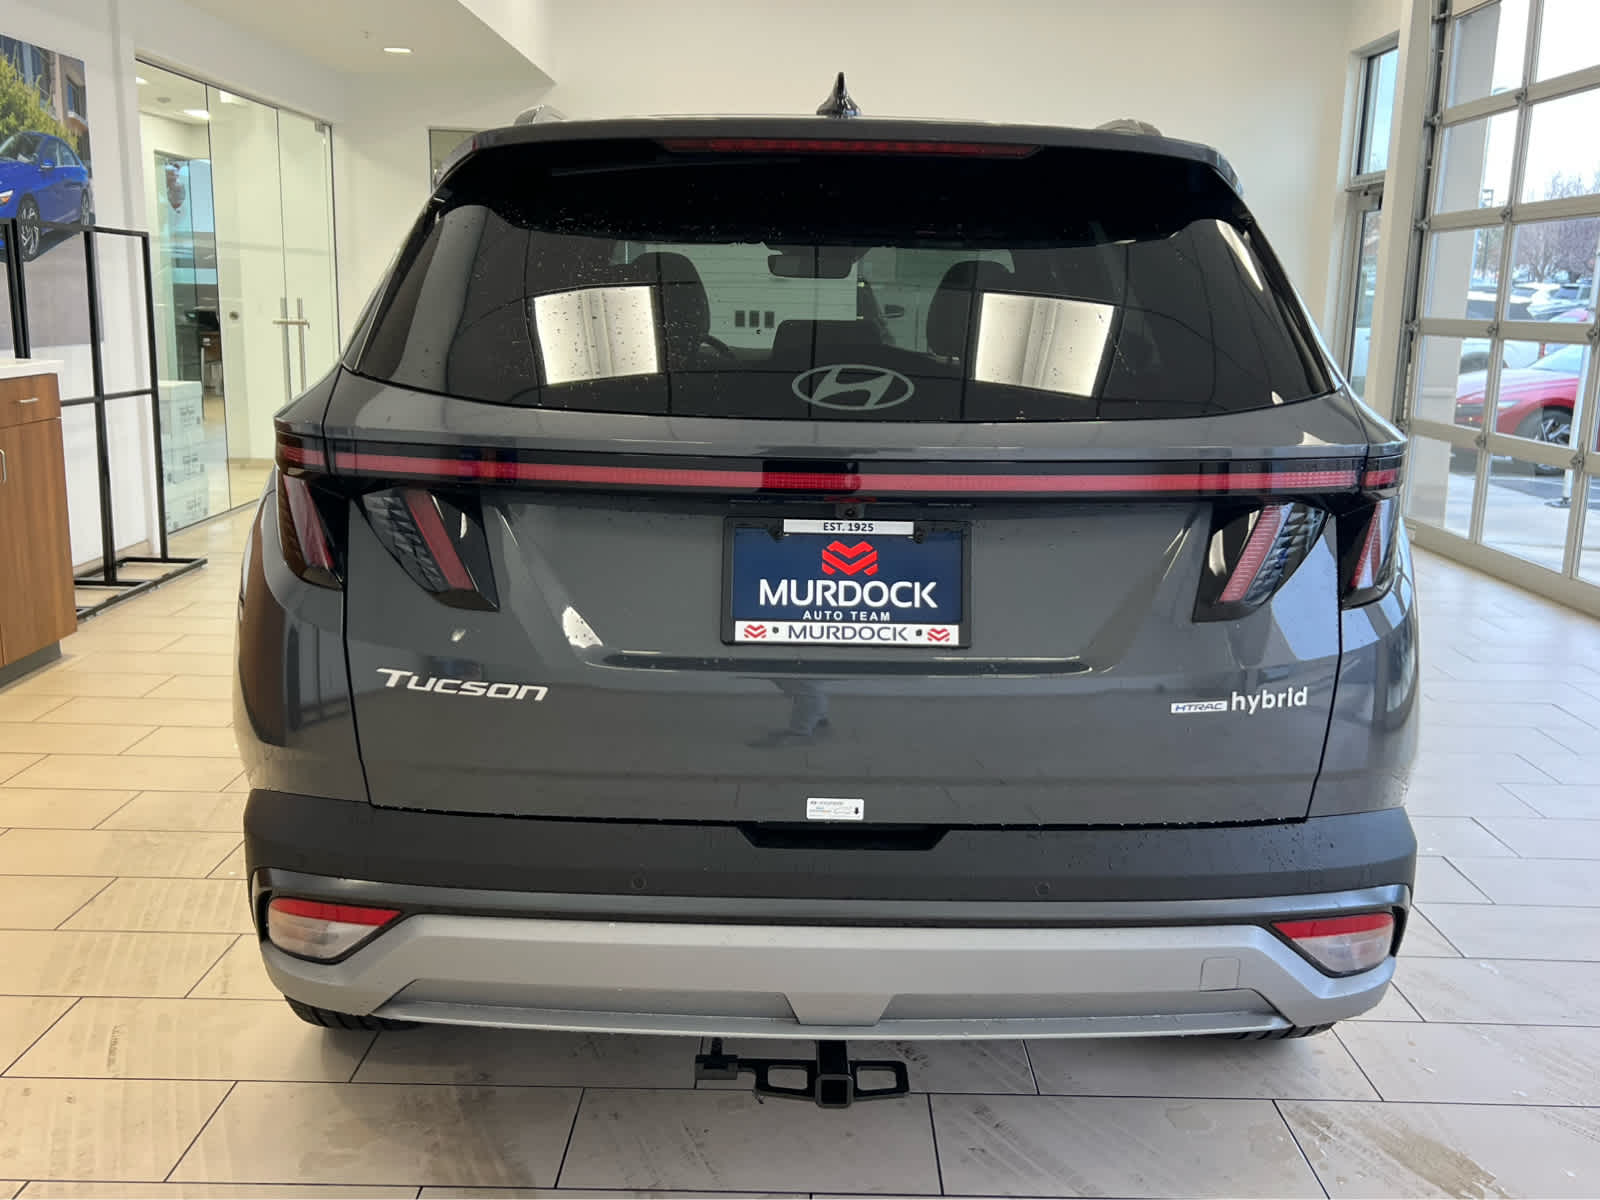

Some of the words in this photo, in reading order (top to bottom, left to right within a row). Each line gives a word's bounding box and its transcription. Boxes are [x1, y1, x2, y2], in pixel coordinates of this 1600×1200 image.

[823, 522, 845, 532] EST.
[848, 523, 874, 532] 1925
[759, 578, 938, 608] MURDOCK
[802, 610, 844, 621] AUTO
[850, 611, 890, 621] TEAM
[788, 625, 908, 641] MURDOCK
[1174, 702, 1224, 712] HTRAC
[1231, 686, 1308, 715] hybrid
